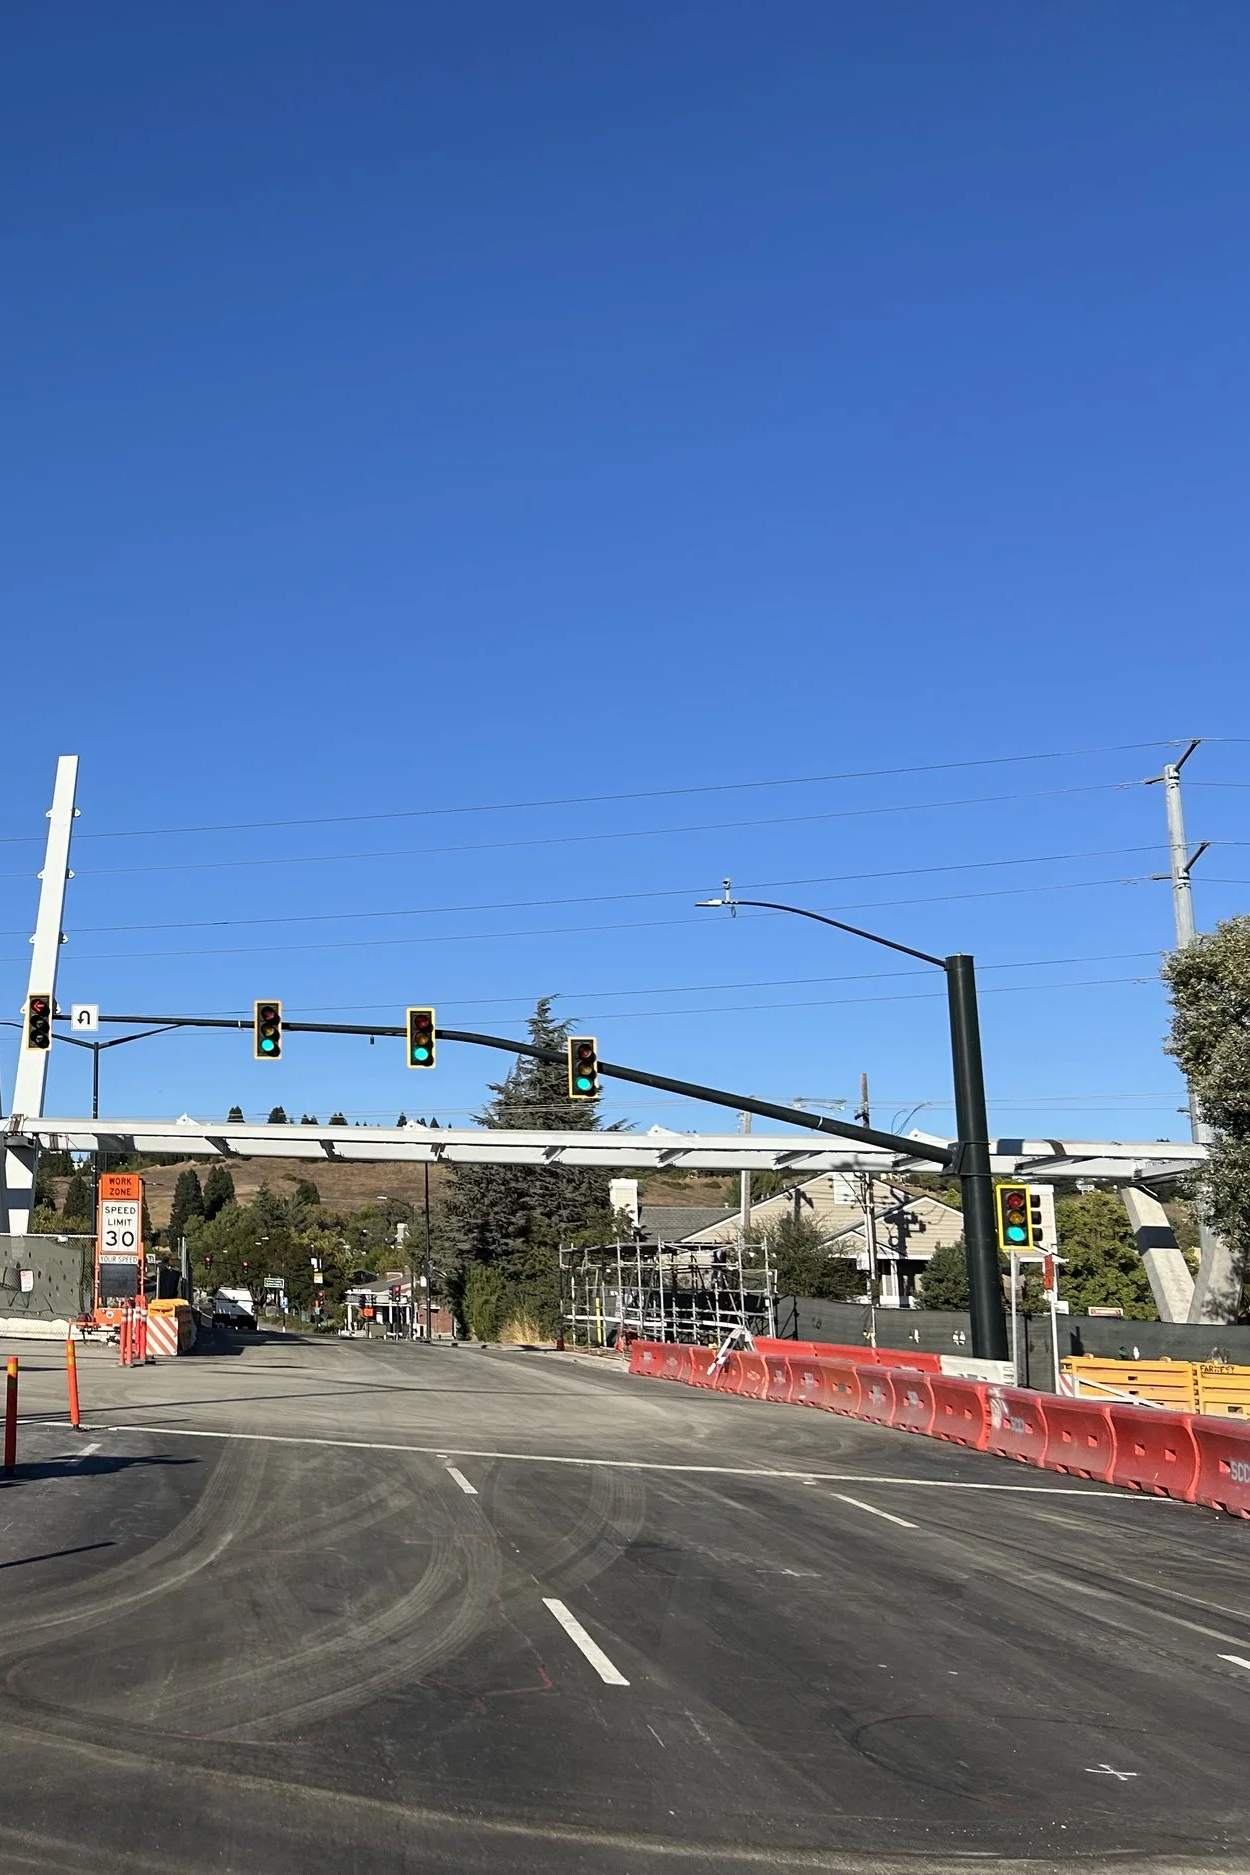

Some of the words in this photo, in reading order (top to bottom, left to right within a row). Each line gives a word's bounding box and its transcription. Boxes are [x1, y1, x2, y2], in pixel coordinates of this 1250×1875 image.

[109, 1177, 132, 1185] WORK
[110, 1188, 131, 1196] ZONE
[105, 1206, 136, 1215] SPEED
[106, 1231, 134, 1247] 30
